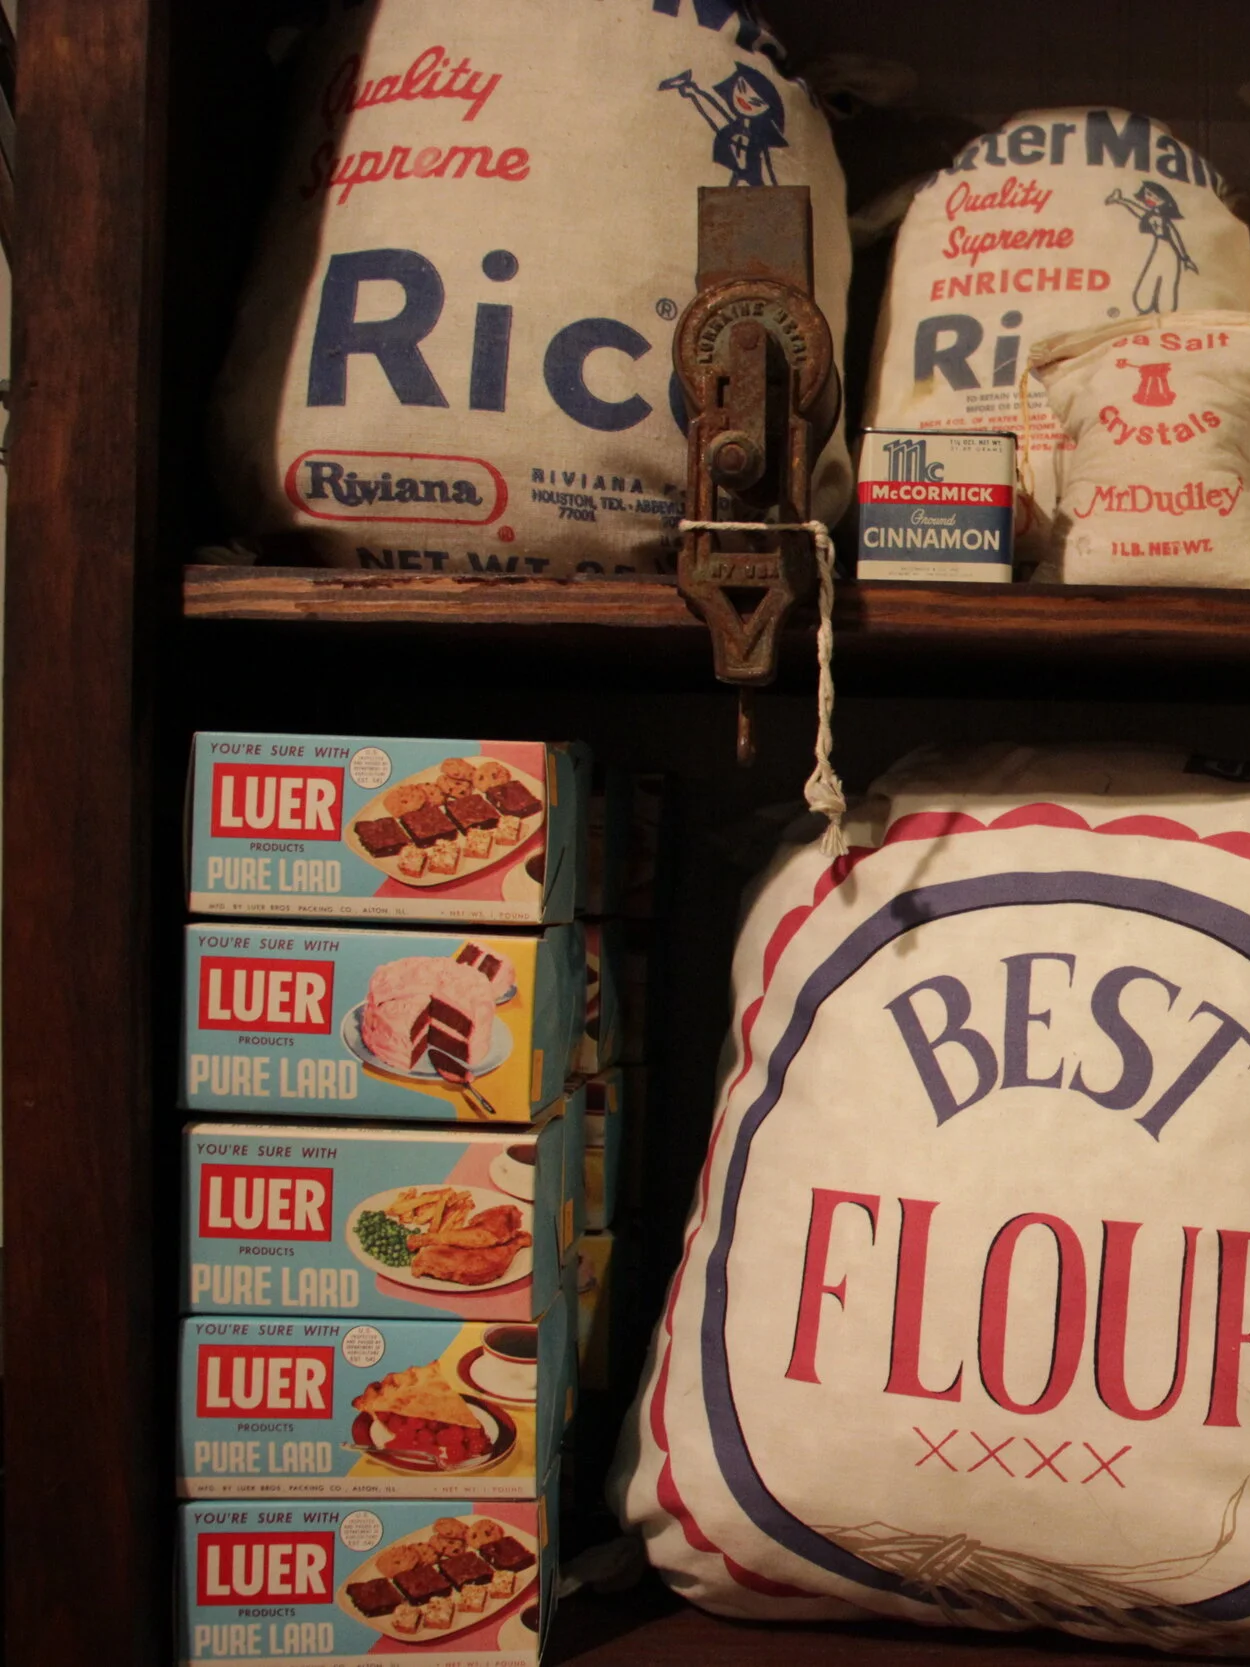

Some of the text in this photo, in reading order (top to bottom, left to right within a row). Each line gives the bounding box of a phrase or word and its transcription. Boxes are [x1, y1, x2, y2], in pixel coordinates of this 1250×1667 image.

[321, 45, 503, 132] Quality
[301, 140, 531, 205] Supreme
[945, 176, 1053, 221] Quality
[942, 225, 1075, 267] Supreme
[929, 268, 1111, 302] ENRICHED
[305, 247, 691, 442] Ric
[913, 311, 1024, 392] Ri
[1160, 331, 1230, 351] Salt
[1099, 405, 1222, 446] Crystals
[304, 460, 484, 507] Riviana
[531, 468, 644, 494] RIVIANA
[871, 484, 994, 503] McCORMICK
[910, 508, 957, 526] Ground
[863, 526, 1001, 551] CINNAMON
[1148, 541, 1180, 557] NET
[210, 743, 350, 759] YOU'RE SURE WITH
[219, 774, 339, 833] LUER
[249, 842, 306, 853] PRODUCTS
[206, 856, 342, 893] PURE LARD
[197, 935, 340, 952] YOU'RE SURE WITH
[207, 967, 327, 1025] LUER
[238, 1035, 295, 1047] PRODUCTS
[189, 1054, 358, 1101] PURE LARD
[197, 1142, 338, 1159] YOU'RE SURE WITH
[207, 1174, 327, 1232] LUER
[238, 1245, 295, 1257] PRODUCTS
[190, 1262, 359, 1308] PURE LARD
[195, 1322, 341, 1338] YOU'RE SURE WITH
[205, 1355, 327, 1411] LUER
[237, 1422, 295, 1433] PRODUCTS
[194, 1440, 333, 1474] PURE LARD
[193, 1511, 340, 1524] YOU'RE SURE WITH
[205, 1542, 327, 1597] LUER
[237, 1607, 296, 1618] PRODUCTS
[194, 1621, 334, 1657] PURE LARD
